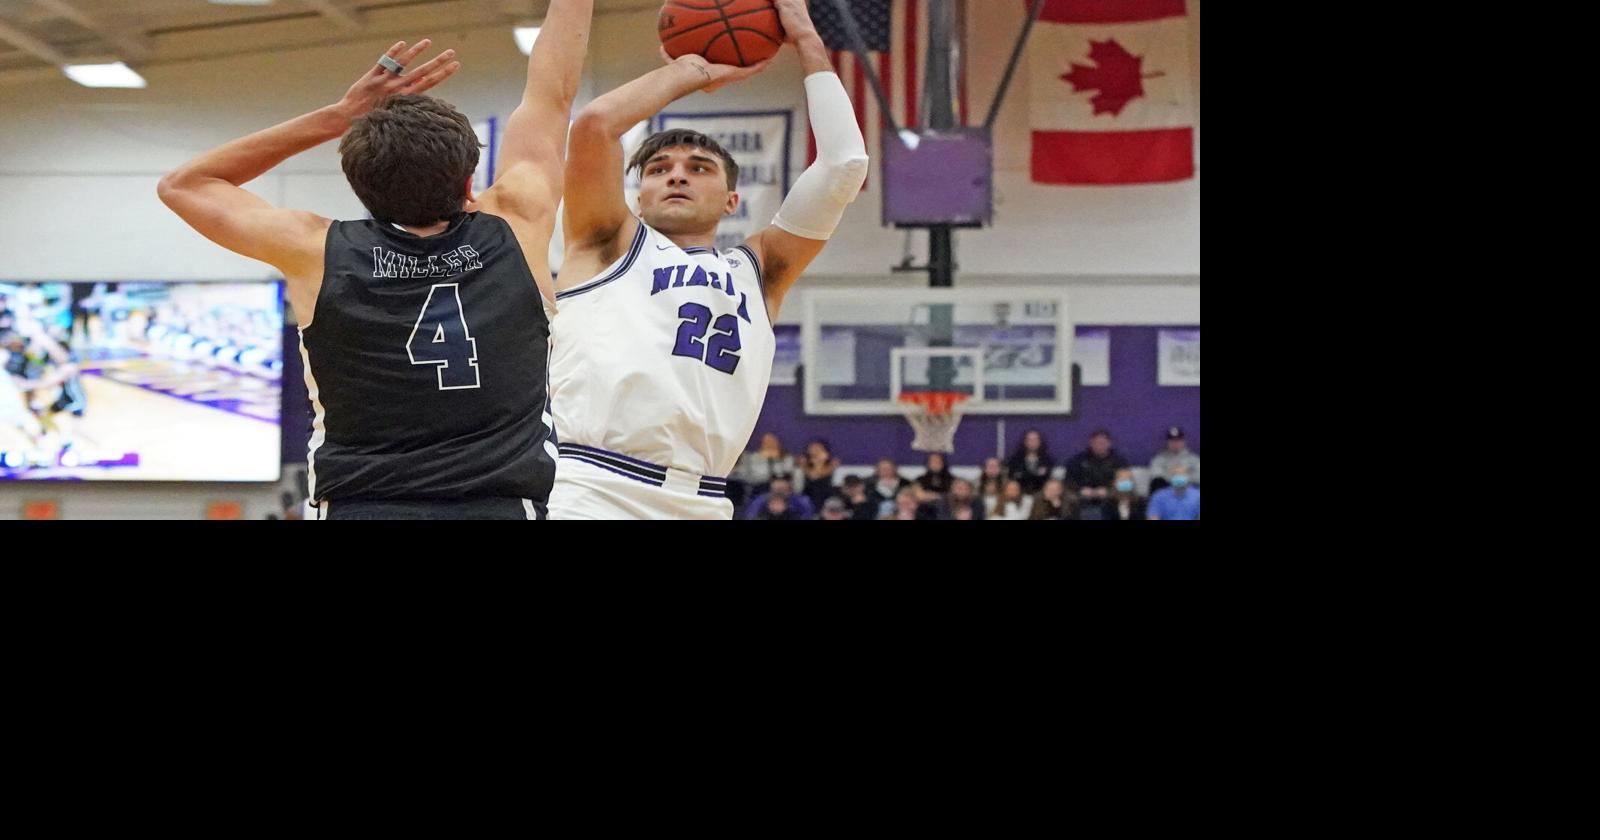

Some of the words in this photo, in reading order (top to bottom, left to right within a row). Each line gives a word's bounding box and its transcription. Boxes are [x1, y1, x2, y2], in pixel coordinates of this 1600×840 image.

[373, 245, 483, 278] MILLER
[406, 283, 480, 391] 4
[671, 302, 741, 375] 22
